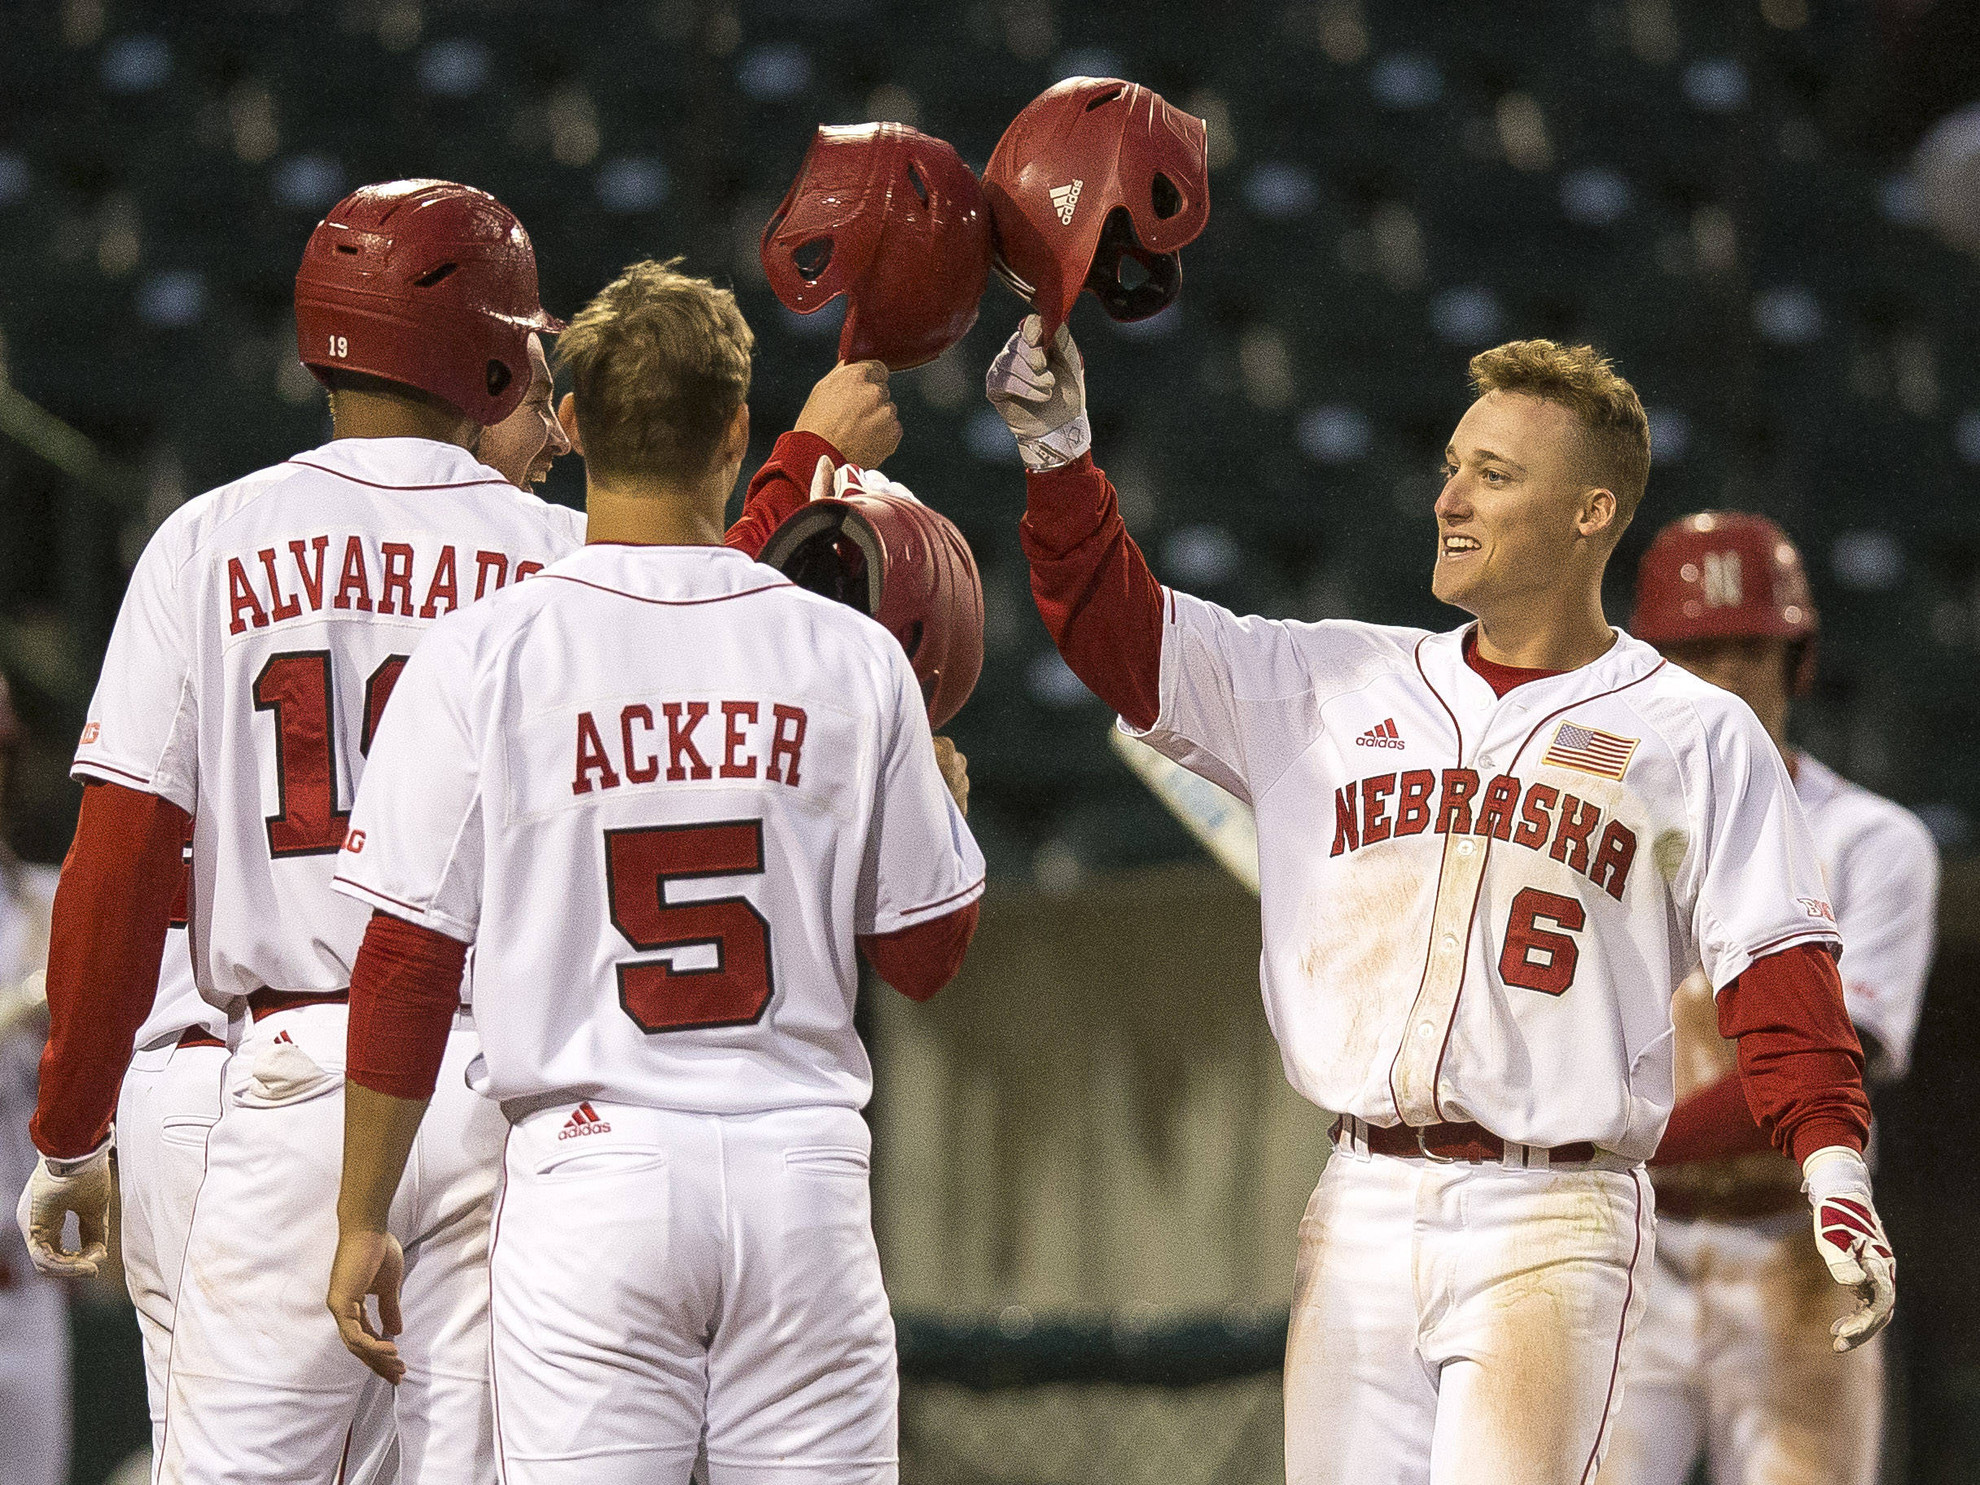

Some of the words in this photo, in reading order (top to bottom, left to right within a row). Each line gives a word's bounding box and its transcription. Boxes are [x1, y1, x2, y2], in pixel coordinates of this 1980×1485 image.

[1061, 179, 1084, 226] adidas
[329, 334, 348, 358] 19
[252, 649, 411, 859] 1
[571, 700, 808, 796] ACKER
[1355, 736, 1406, 751] adidas
[1329, 768, 1638, 902] NEBRASKA
[603, 818, 775, 1035] 5
[1498, 886, 1586, 997] 6
[557, 1121, 612, 1141] adidas
